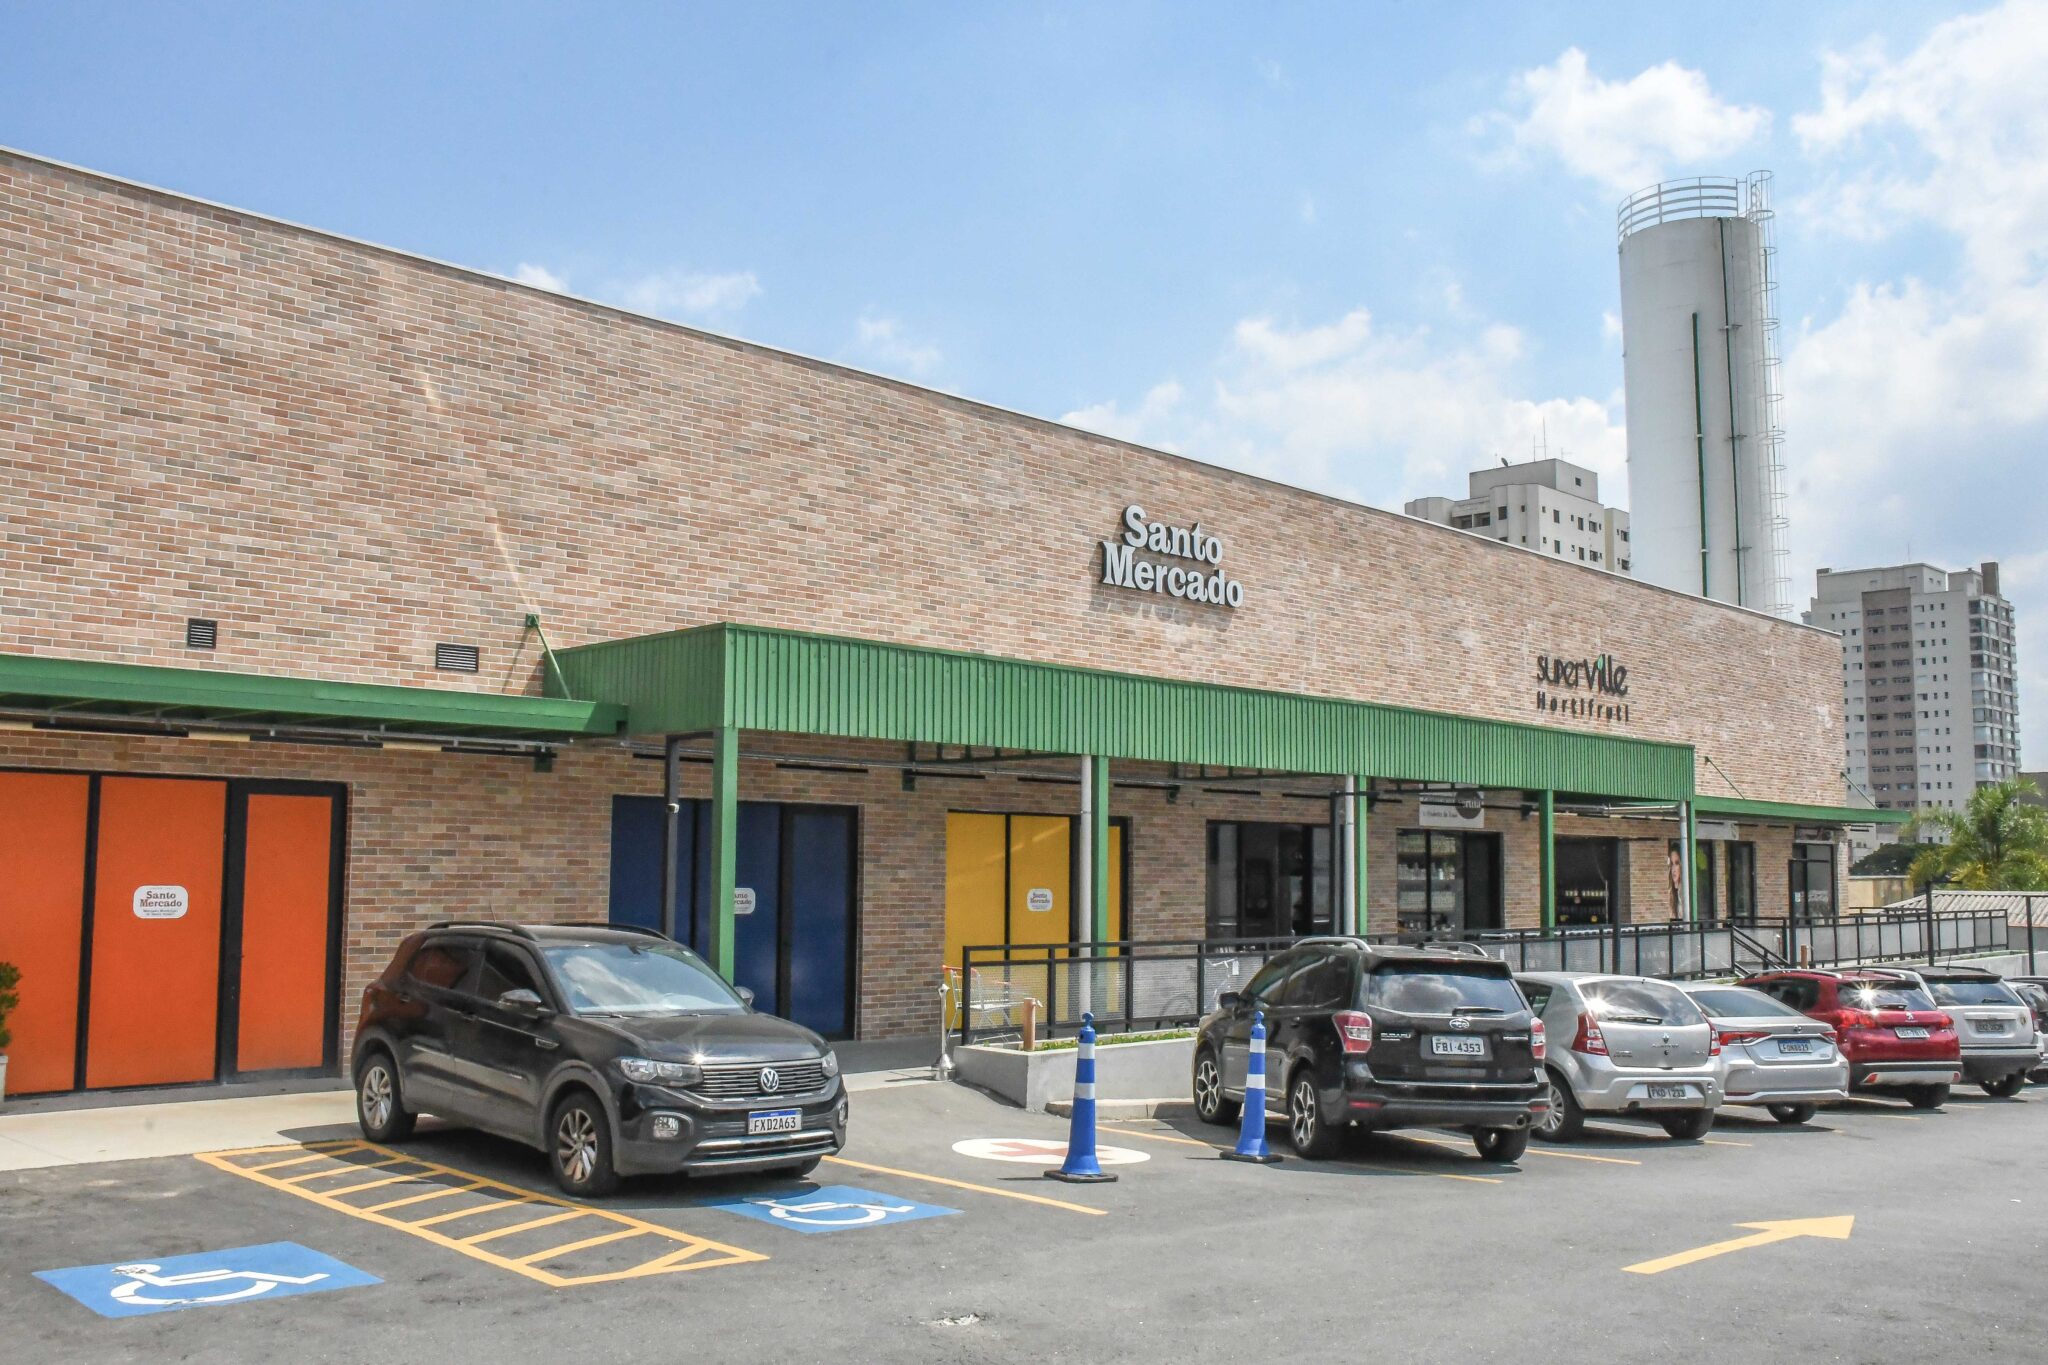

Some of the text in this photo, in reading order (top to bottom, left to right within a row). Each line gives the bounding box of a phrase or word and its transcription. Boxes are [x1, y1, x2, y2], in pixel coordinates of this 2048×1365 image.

[1121, 504, 1224, 565] Santo
[1098, 541, 1244, 608] Mercado
[140, 898, 182, 907] Mercado
[146, 890, 176, 899] Santo
[753, 1116, 797, 1132] FXD2A63
